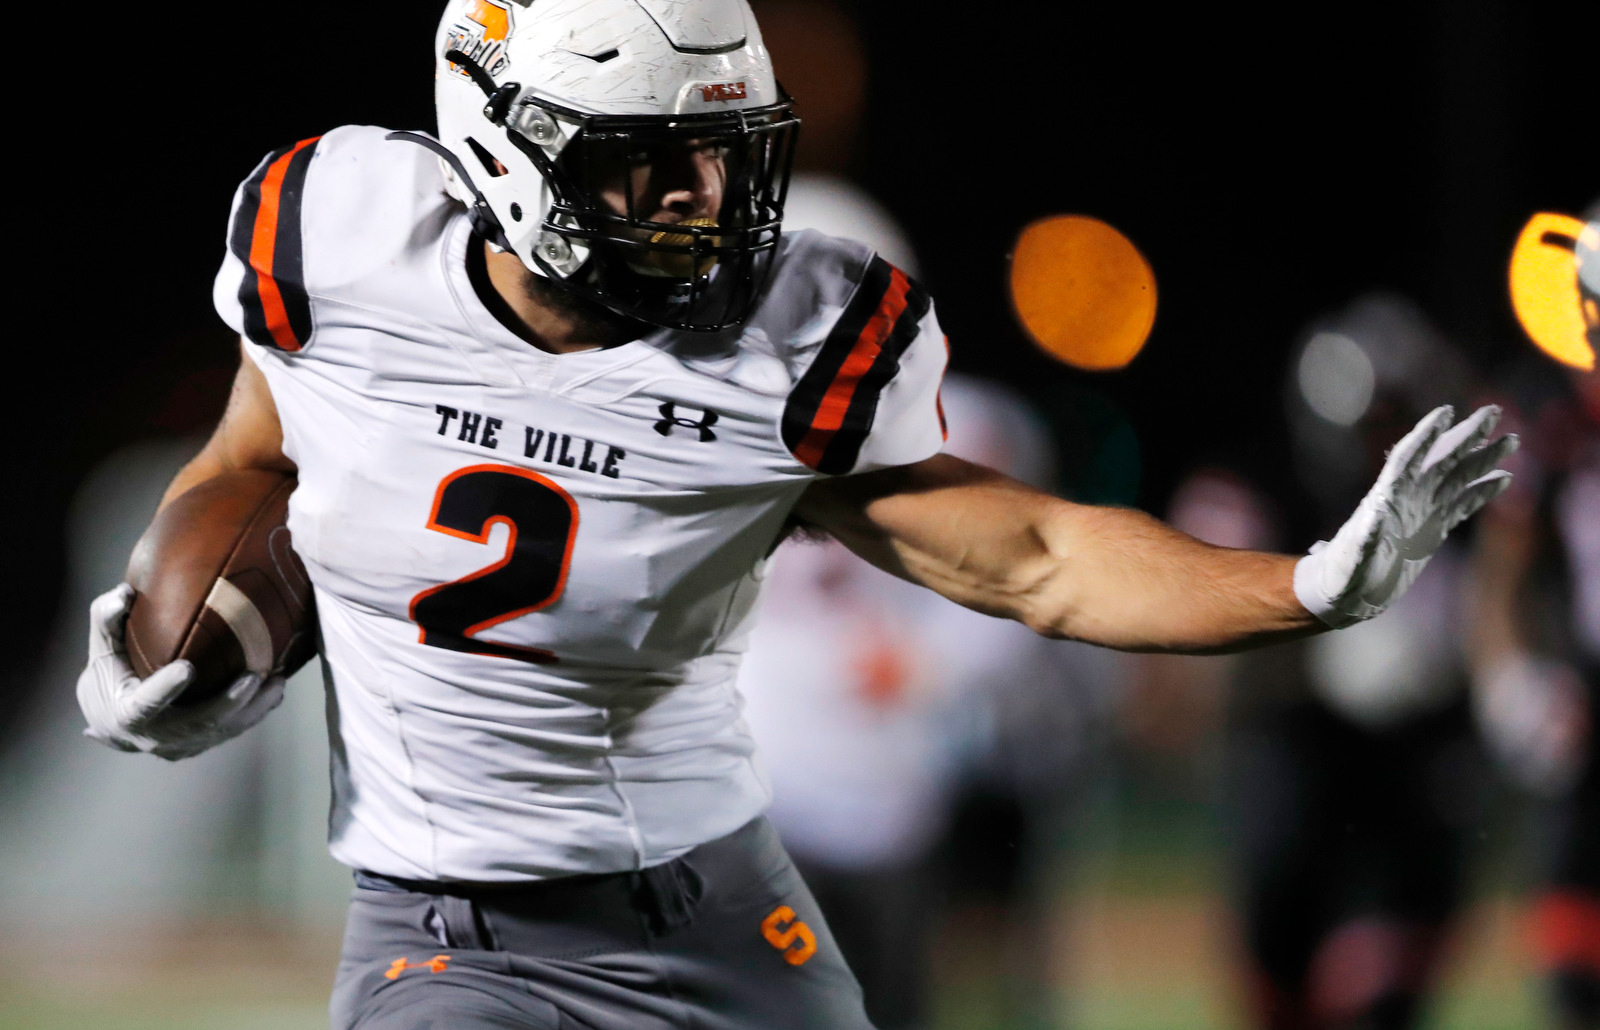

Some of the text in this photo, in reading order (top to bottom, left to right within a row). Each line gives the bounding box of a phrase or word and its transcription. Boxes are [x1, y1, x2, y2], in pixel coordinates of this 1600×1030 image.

[435, 403, 626, 479] THE VILLE
[408, 463, 580, 665] 2
[760, 905, 818, 966] S
